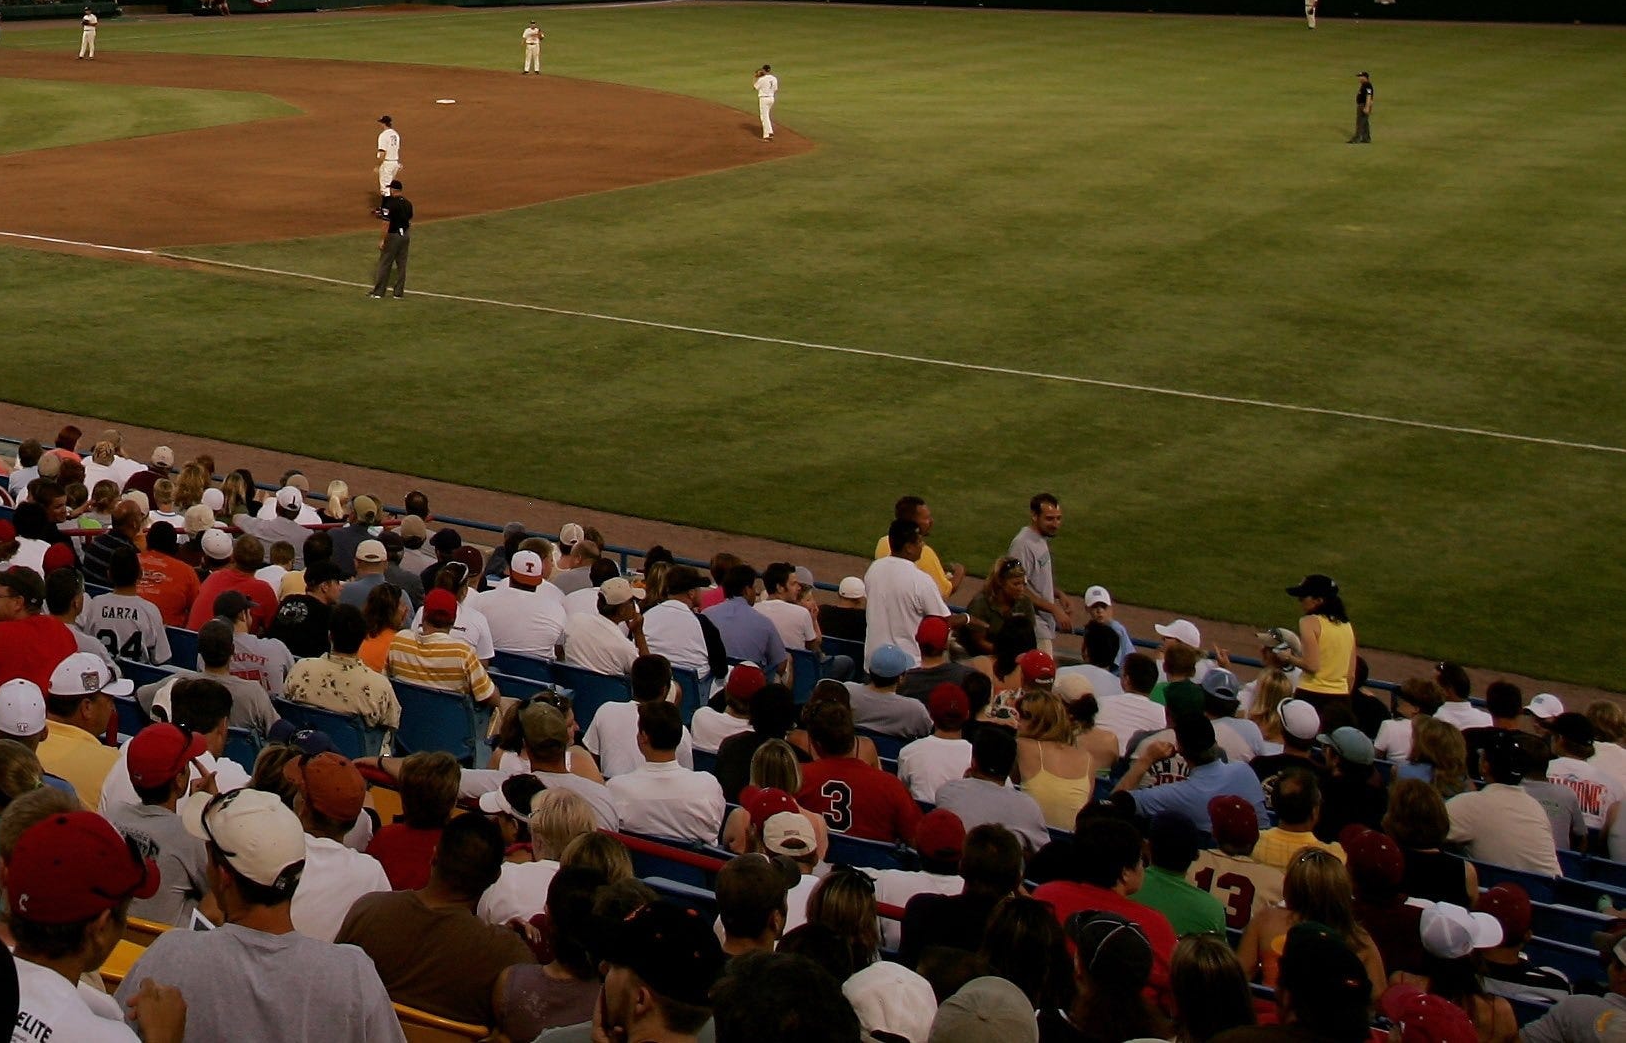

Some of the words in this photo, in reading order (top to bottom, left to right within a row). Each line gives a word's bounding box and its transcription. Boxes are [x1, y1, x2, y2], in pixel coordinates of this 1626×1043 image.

[525, 562, 535, 573] T
[101, 605, 139, 620] GARZA
[821, 779, 853, 833] 3
[1194, 866, 1256, 931] 13
[16, 1011, 53, 1043] ELITE
